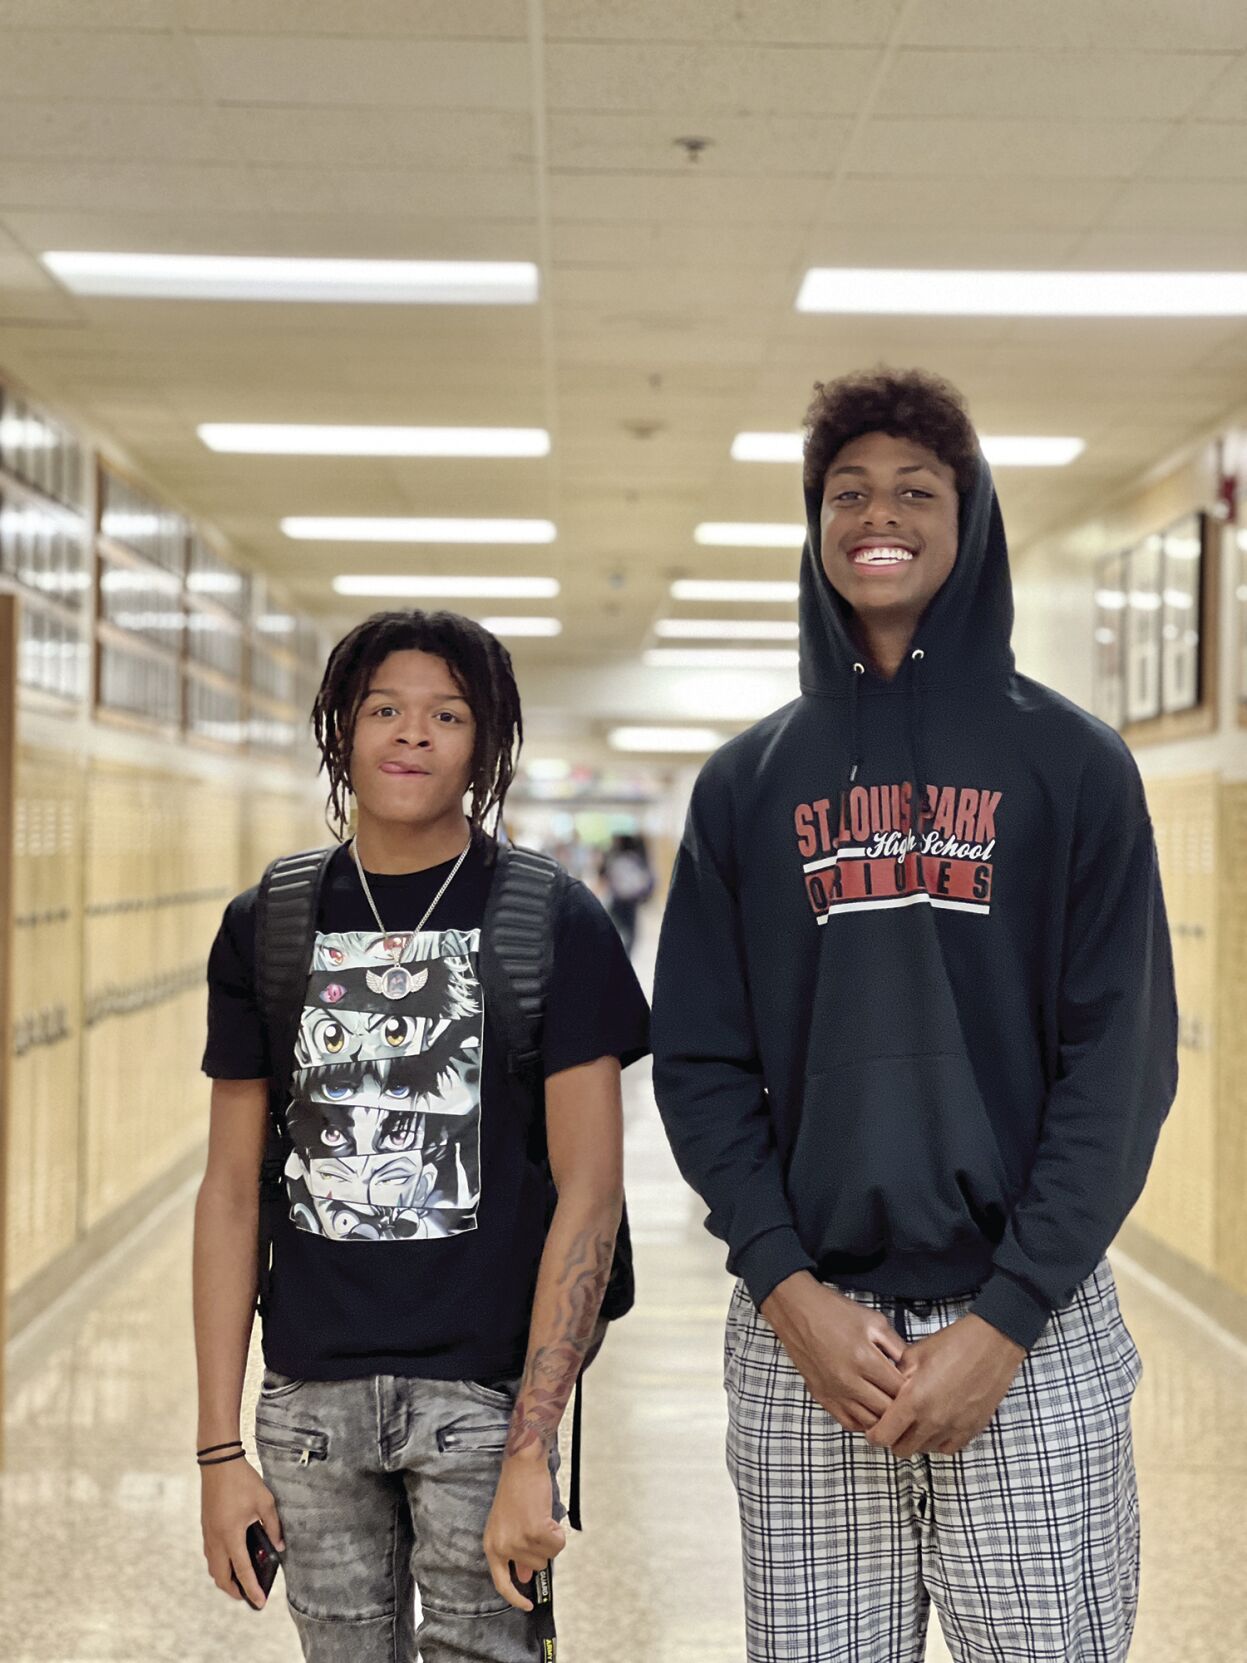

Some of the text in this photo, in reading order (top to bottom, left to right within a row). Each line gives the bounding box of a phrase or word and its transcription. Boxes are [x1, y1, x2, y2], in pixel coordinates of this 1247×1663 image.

[839, 781, 912, 842] LOUIS
[917, 784, 1002, 843] PARK
[866, 828, 996, 864] High School
